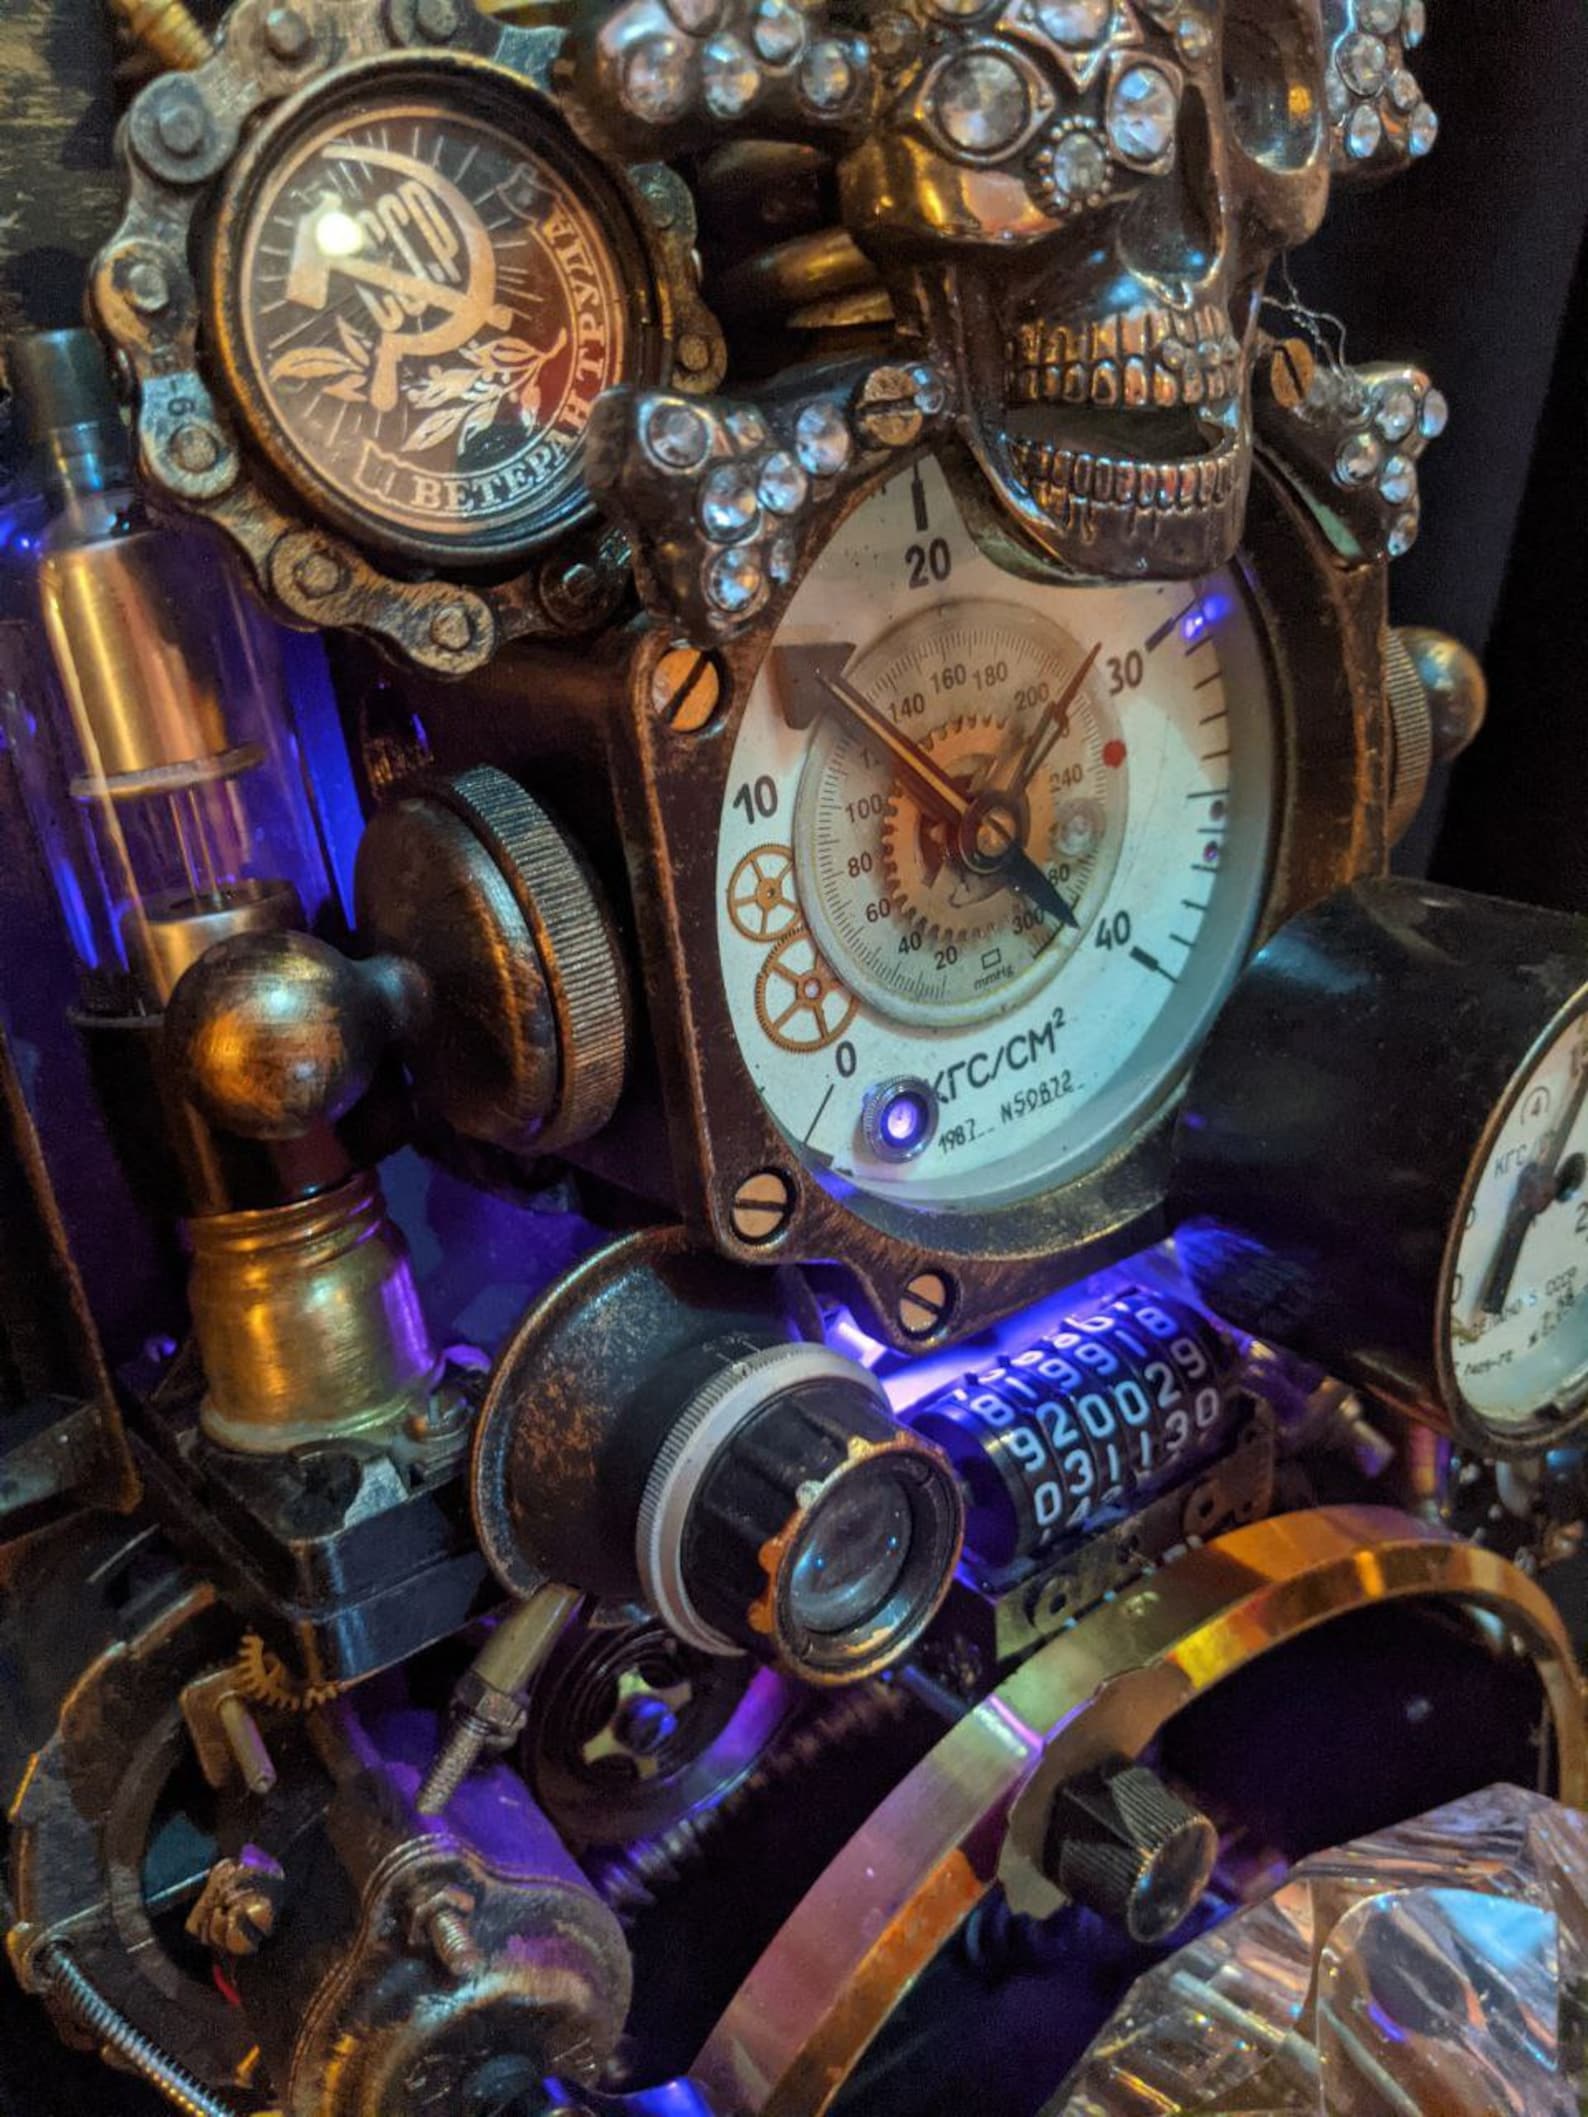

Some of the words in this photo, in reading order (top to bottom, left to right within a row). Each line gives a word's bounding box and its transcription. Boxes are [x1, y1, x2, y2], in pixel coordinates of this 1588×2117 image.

[411, 389, 593, 511] ВЕТЕРАН
[543, 206, 605, 381] ТРУДА
[905, 537, 952, 589] 20
[929, 663, 967, 694] 160
[972, 661, 1008, 691] 180
[1106, 650, 1143, 695] 30
[888, 693, 925, 723] 140
[1014, 682, 1049, 712] 200
[1050, 763, 1083, 793] 240
[733, 776, 777, 824] 10
[845, 794, 882, 823] 100
[847, 852, 872, 878] 80
[1048, 863, 1070, 887] 80
[866, 898, 890, 923] 60
[1012, 905, 1044, 935] 300
[898, 931, 922, 955] 40
[1095, 910, 1131, 952] 40
[934, 945, 957, 970] 20
[834, 1041, 857, 1078] 0
[1008, 1338, 1207, 1473] 920029
[1034, 1387, 1220, 1527] 031130
